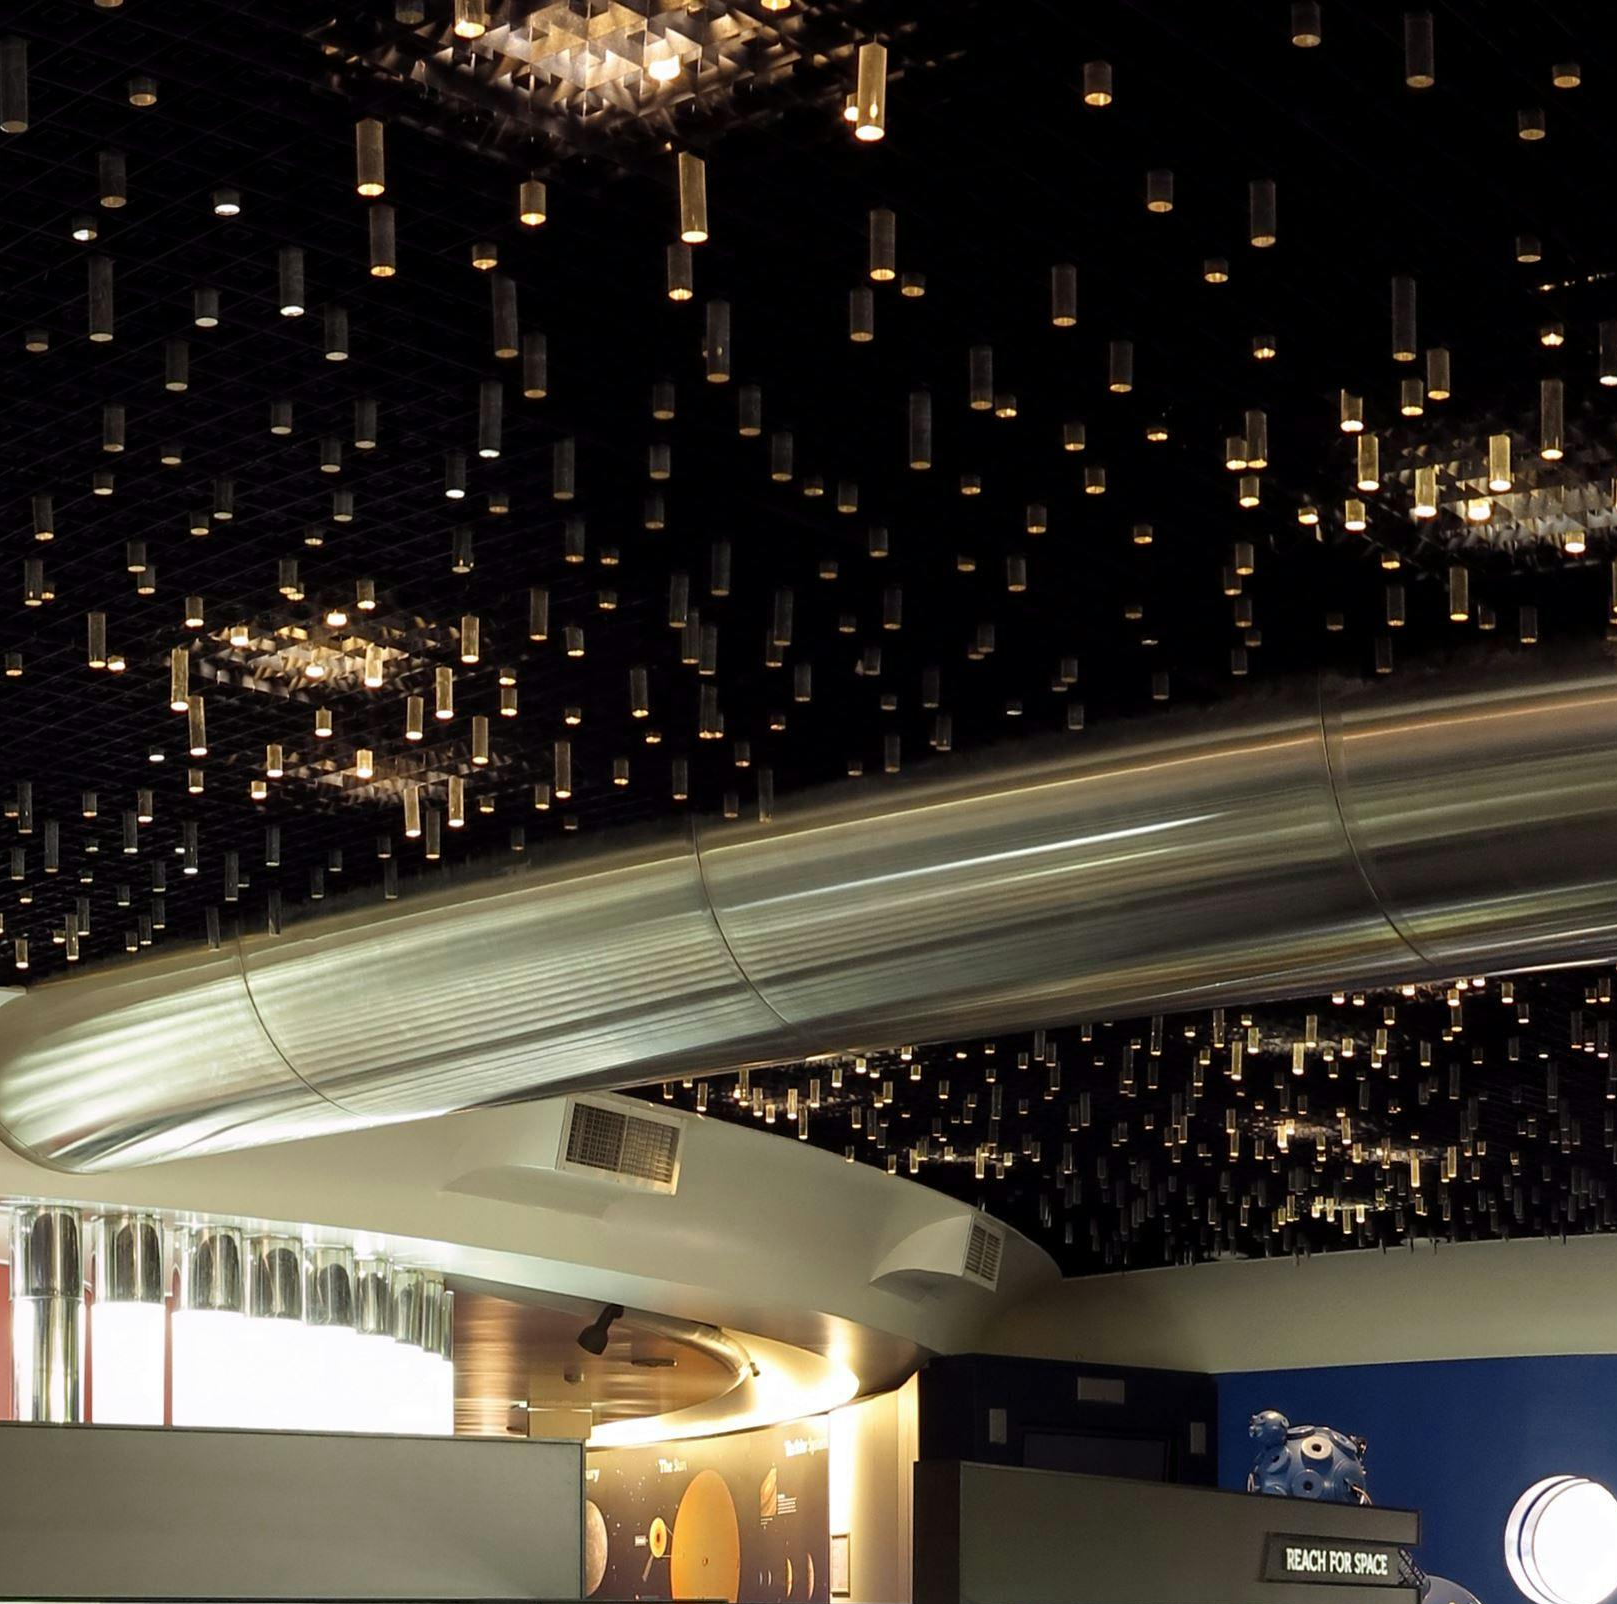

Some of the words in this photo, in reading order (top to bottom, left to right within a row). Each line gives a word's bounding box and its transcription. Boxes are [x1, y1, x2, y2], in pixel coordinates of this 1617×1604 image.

[1286, 1548, 1326, 1572] REACH
[1329, 1551, 1352, 1573] FOR
[1354, 1552, 1388, 1575] SPACE
